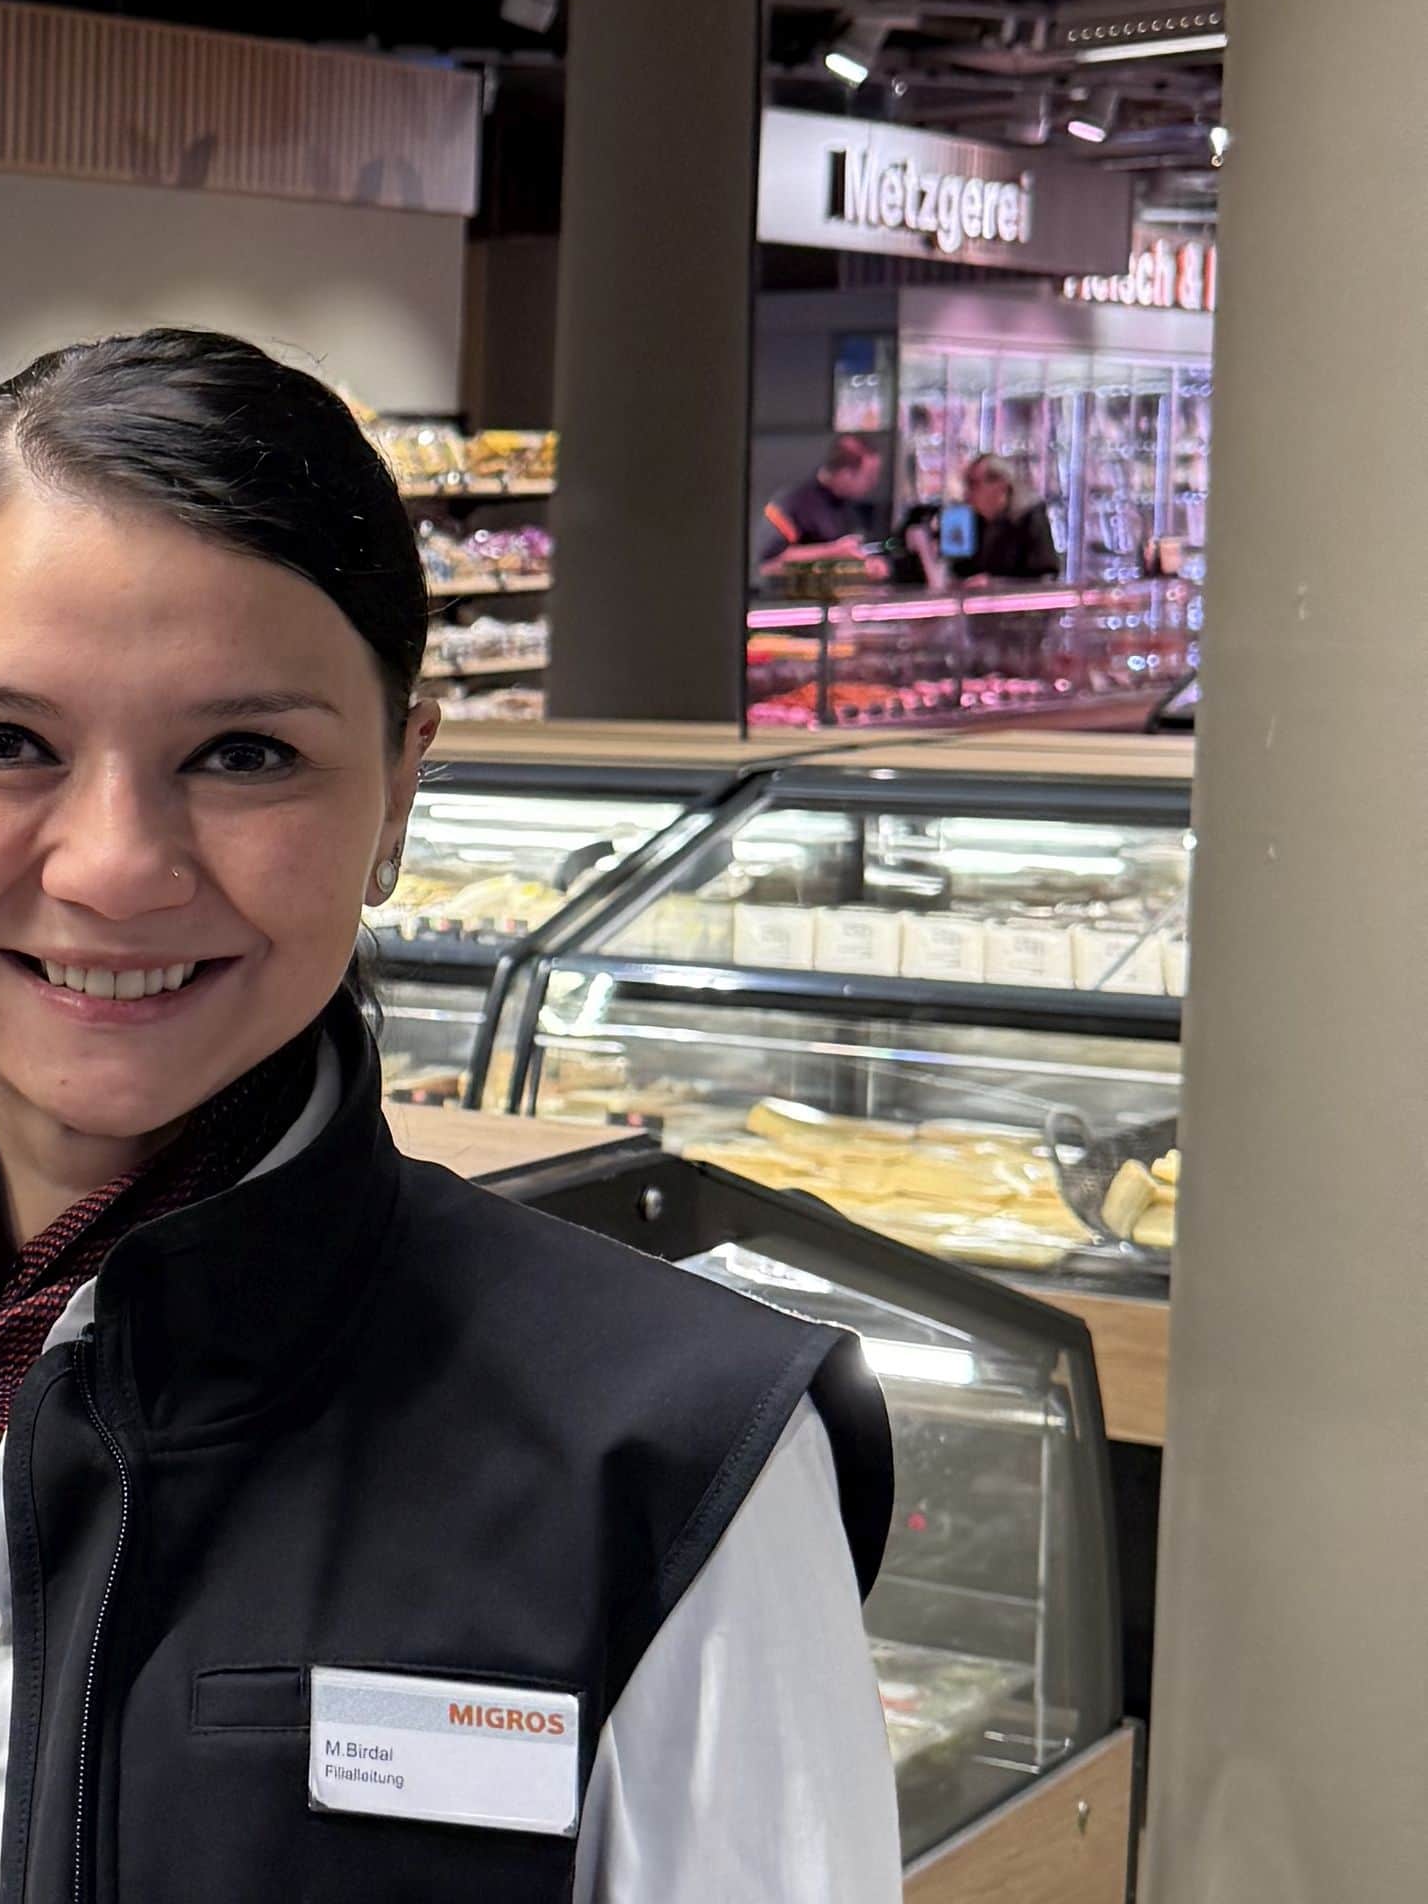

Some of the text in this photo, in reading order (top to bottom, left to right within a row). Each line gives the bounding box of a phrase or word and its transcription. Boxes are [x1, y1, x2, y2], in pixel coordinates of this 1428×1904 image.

[844, 151, 1030, 253] Metzgerei
[449, 1703, 565, 1735] MIGROS
[325, 1765, 404, 1789] Filialleitung
